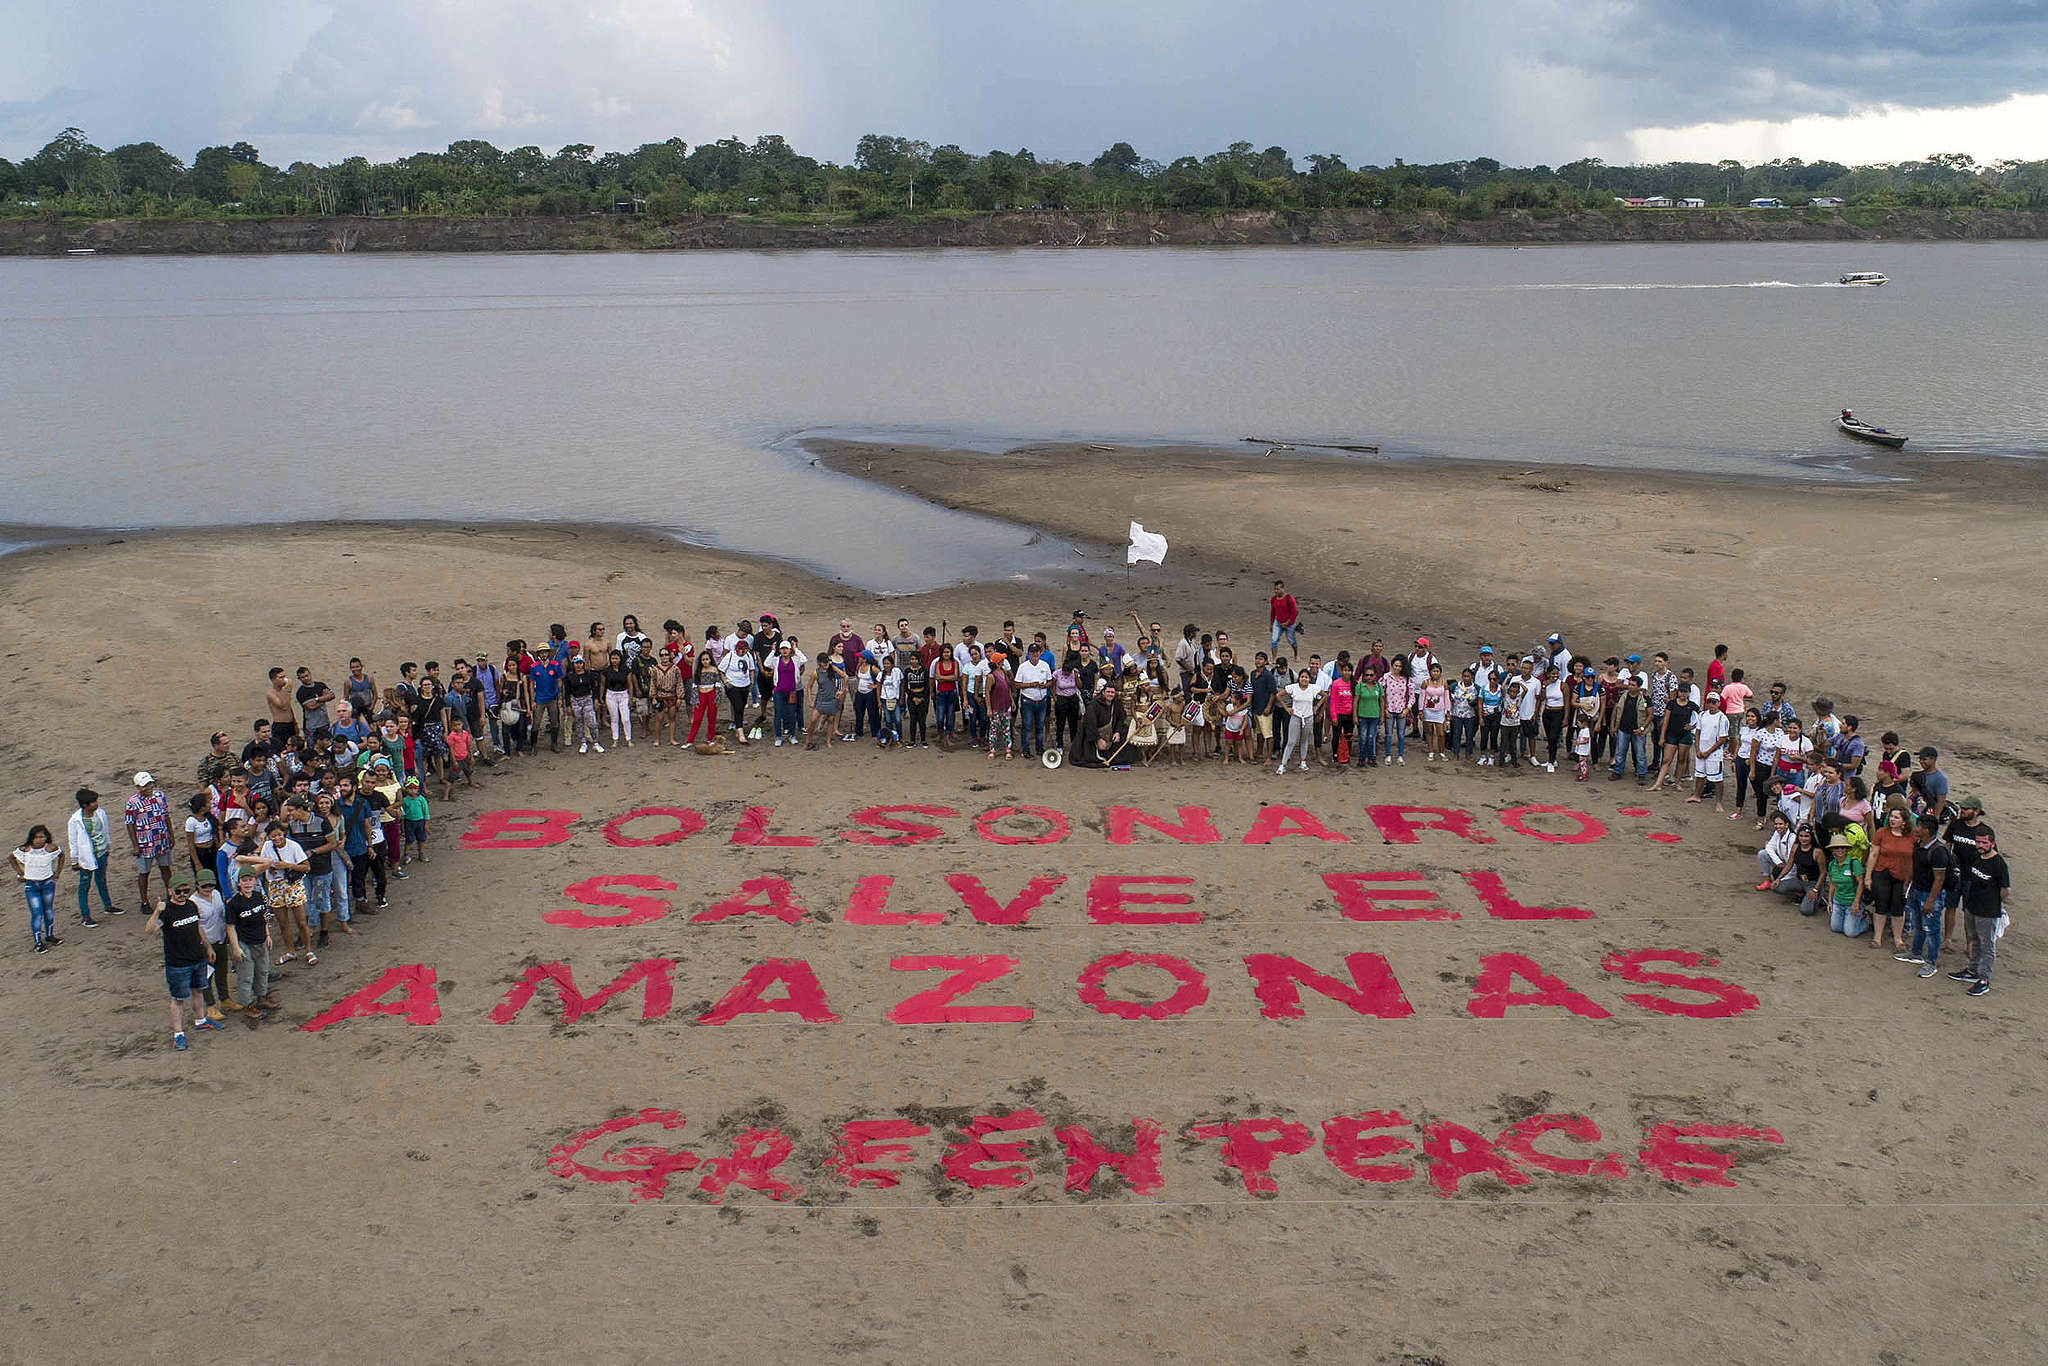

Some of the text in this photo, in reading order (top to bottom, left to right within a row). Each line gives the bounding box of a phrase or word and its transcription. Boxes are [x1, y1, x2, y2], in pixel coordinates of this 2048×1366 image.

[459, 804, 1684, 850] BOLSONARO:
[541, 870, 1596, 929] SALVE EL
[301, 949, 1763, 1033] AMAZONAS
[546, 1107, 1785, 1205] GREENPEACE
